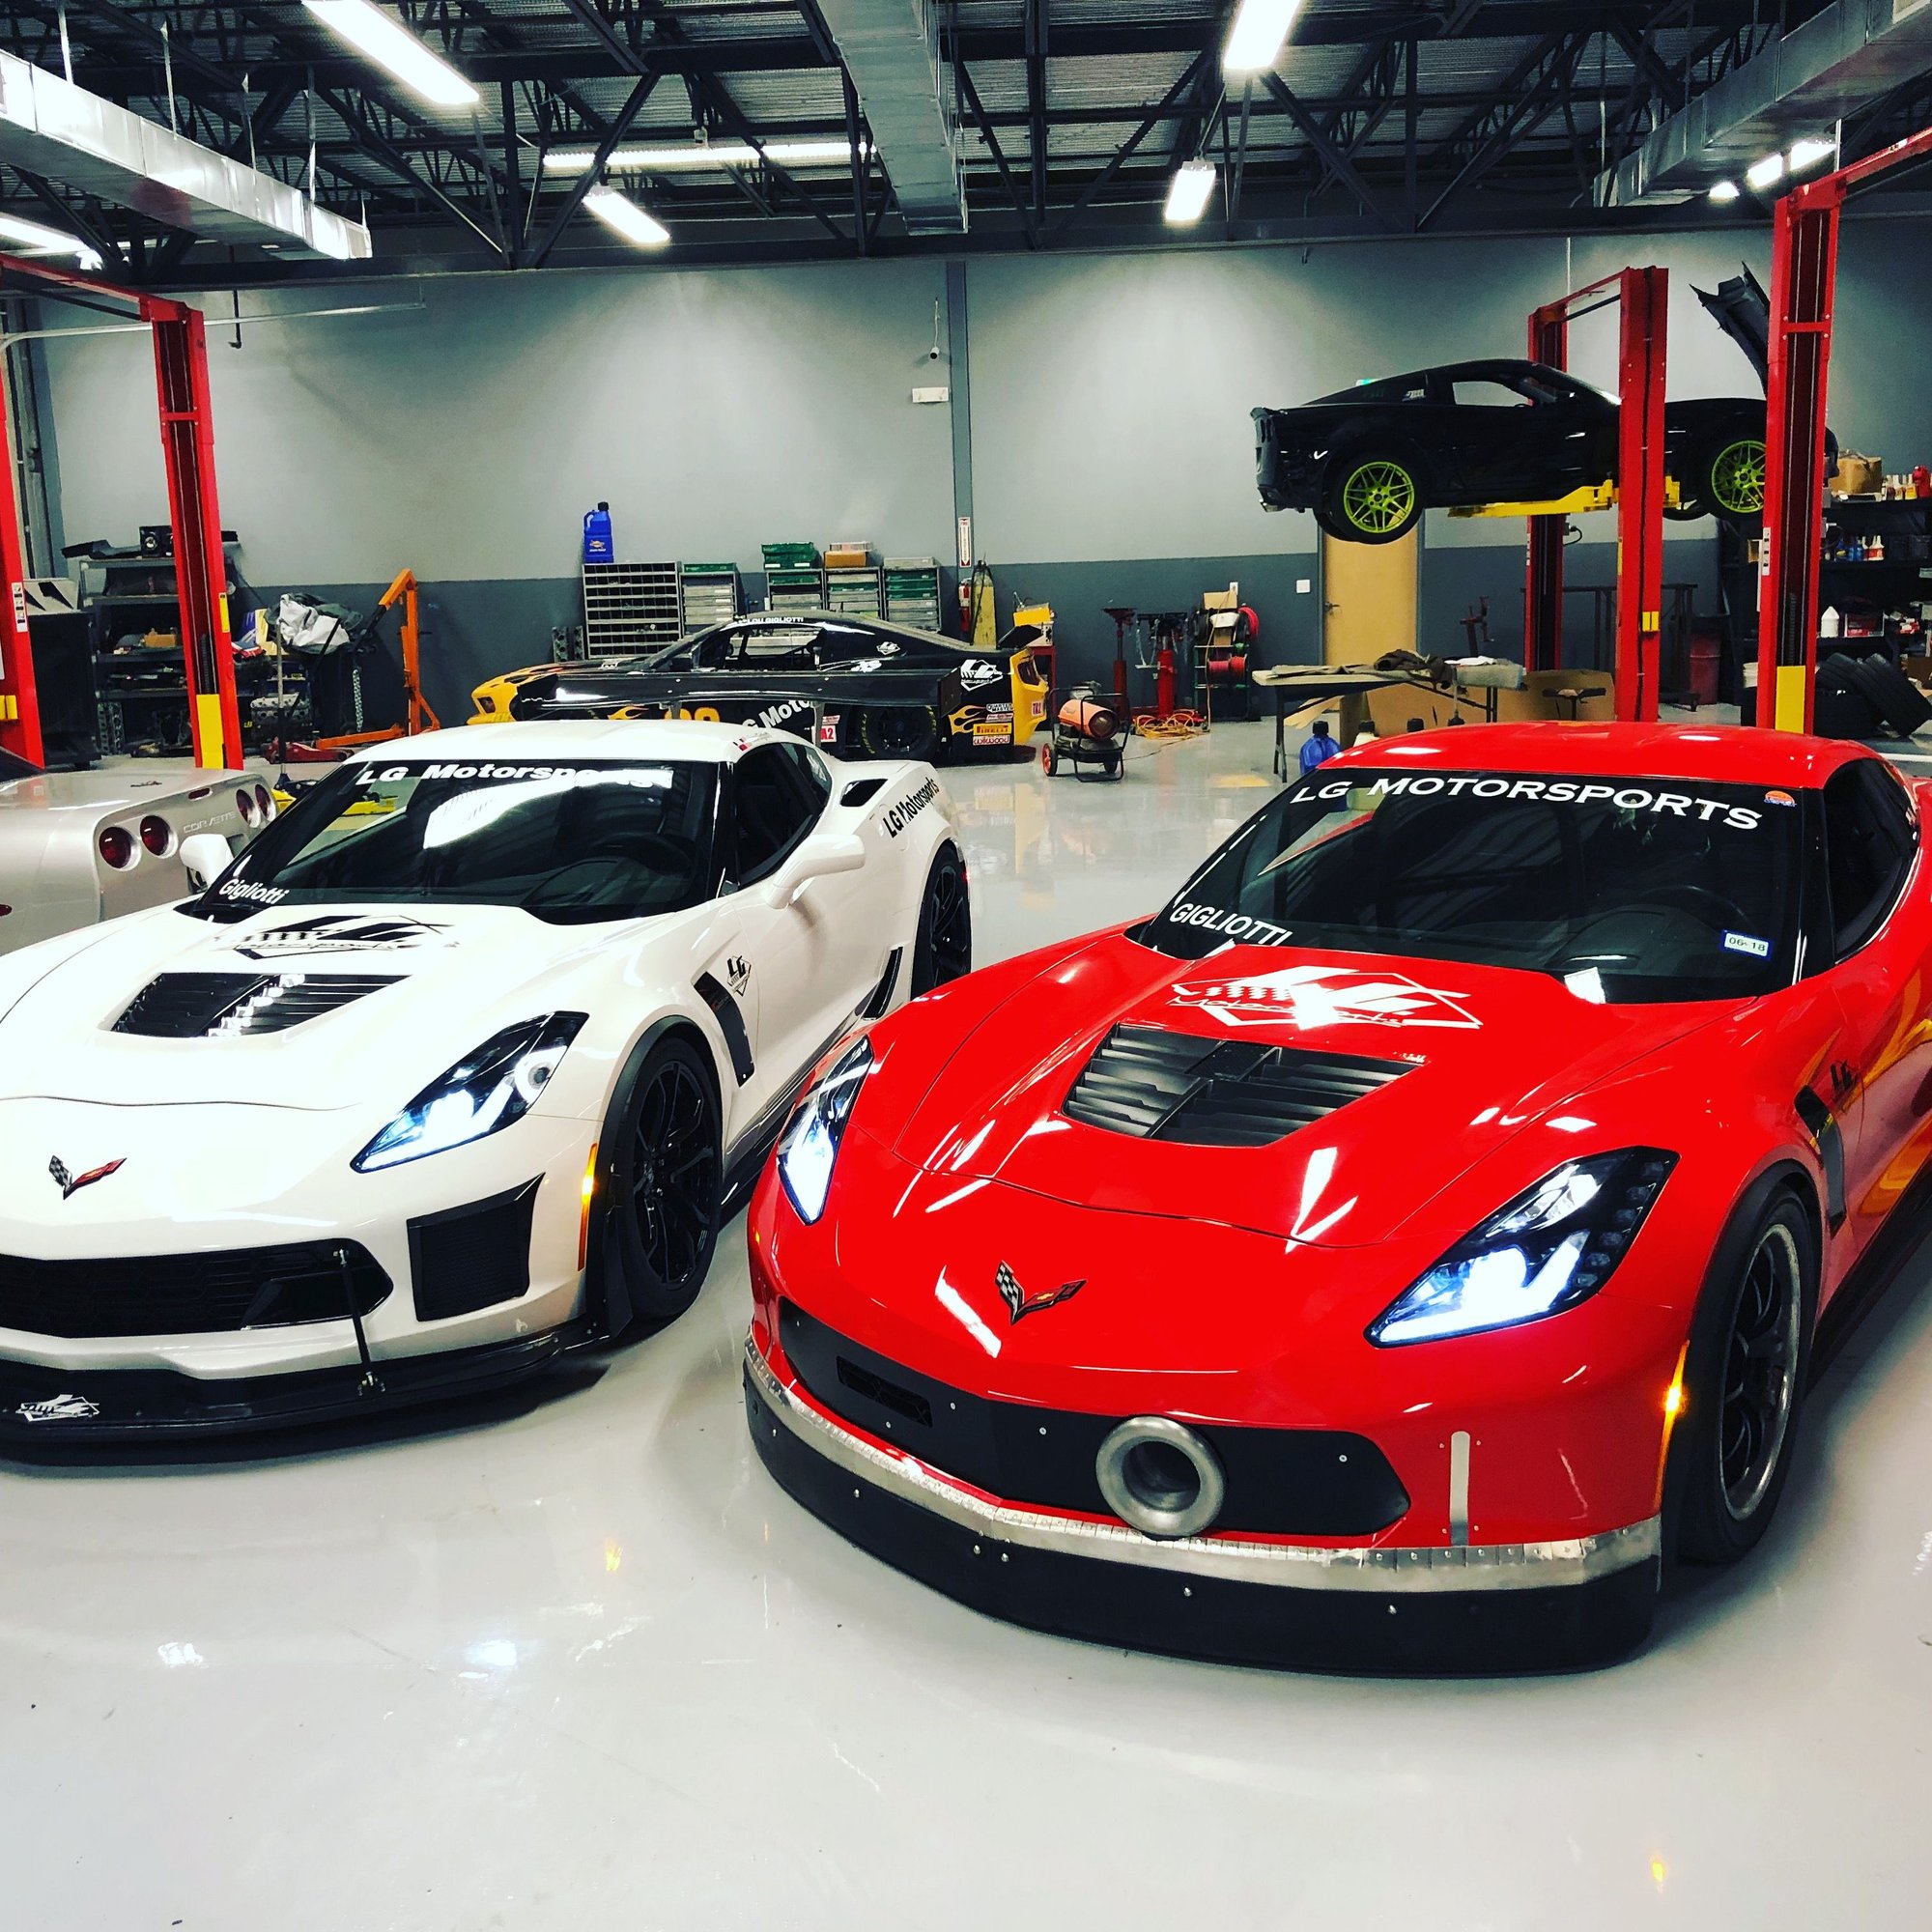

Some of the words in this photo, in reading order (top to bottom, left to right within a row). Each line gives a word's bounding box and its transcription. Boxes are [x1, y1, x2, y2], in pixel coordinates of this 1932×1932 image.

[355, 767, 409, 785] LG
[883, 810, 904, 838] LG
[895, 777, 939, 824] Motorsports
[1290, 781, 1350, 804] LG
[1366, 779, 1762, 830] MOTORSPORTS
[218, 878, 290, 905] Gigliotti
[1169, 902, 1293, 947] GIGLIOTTI
